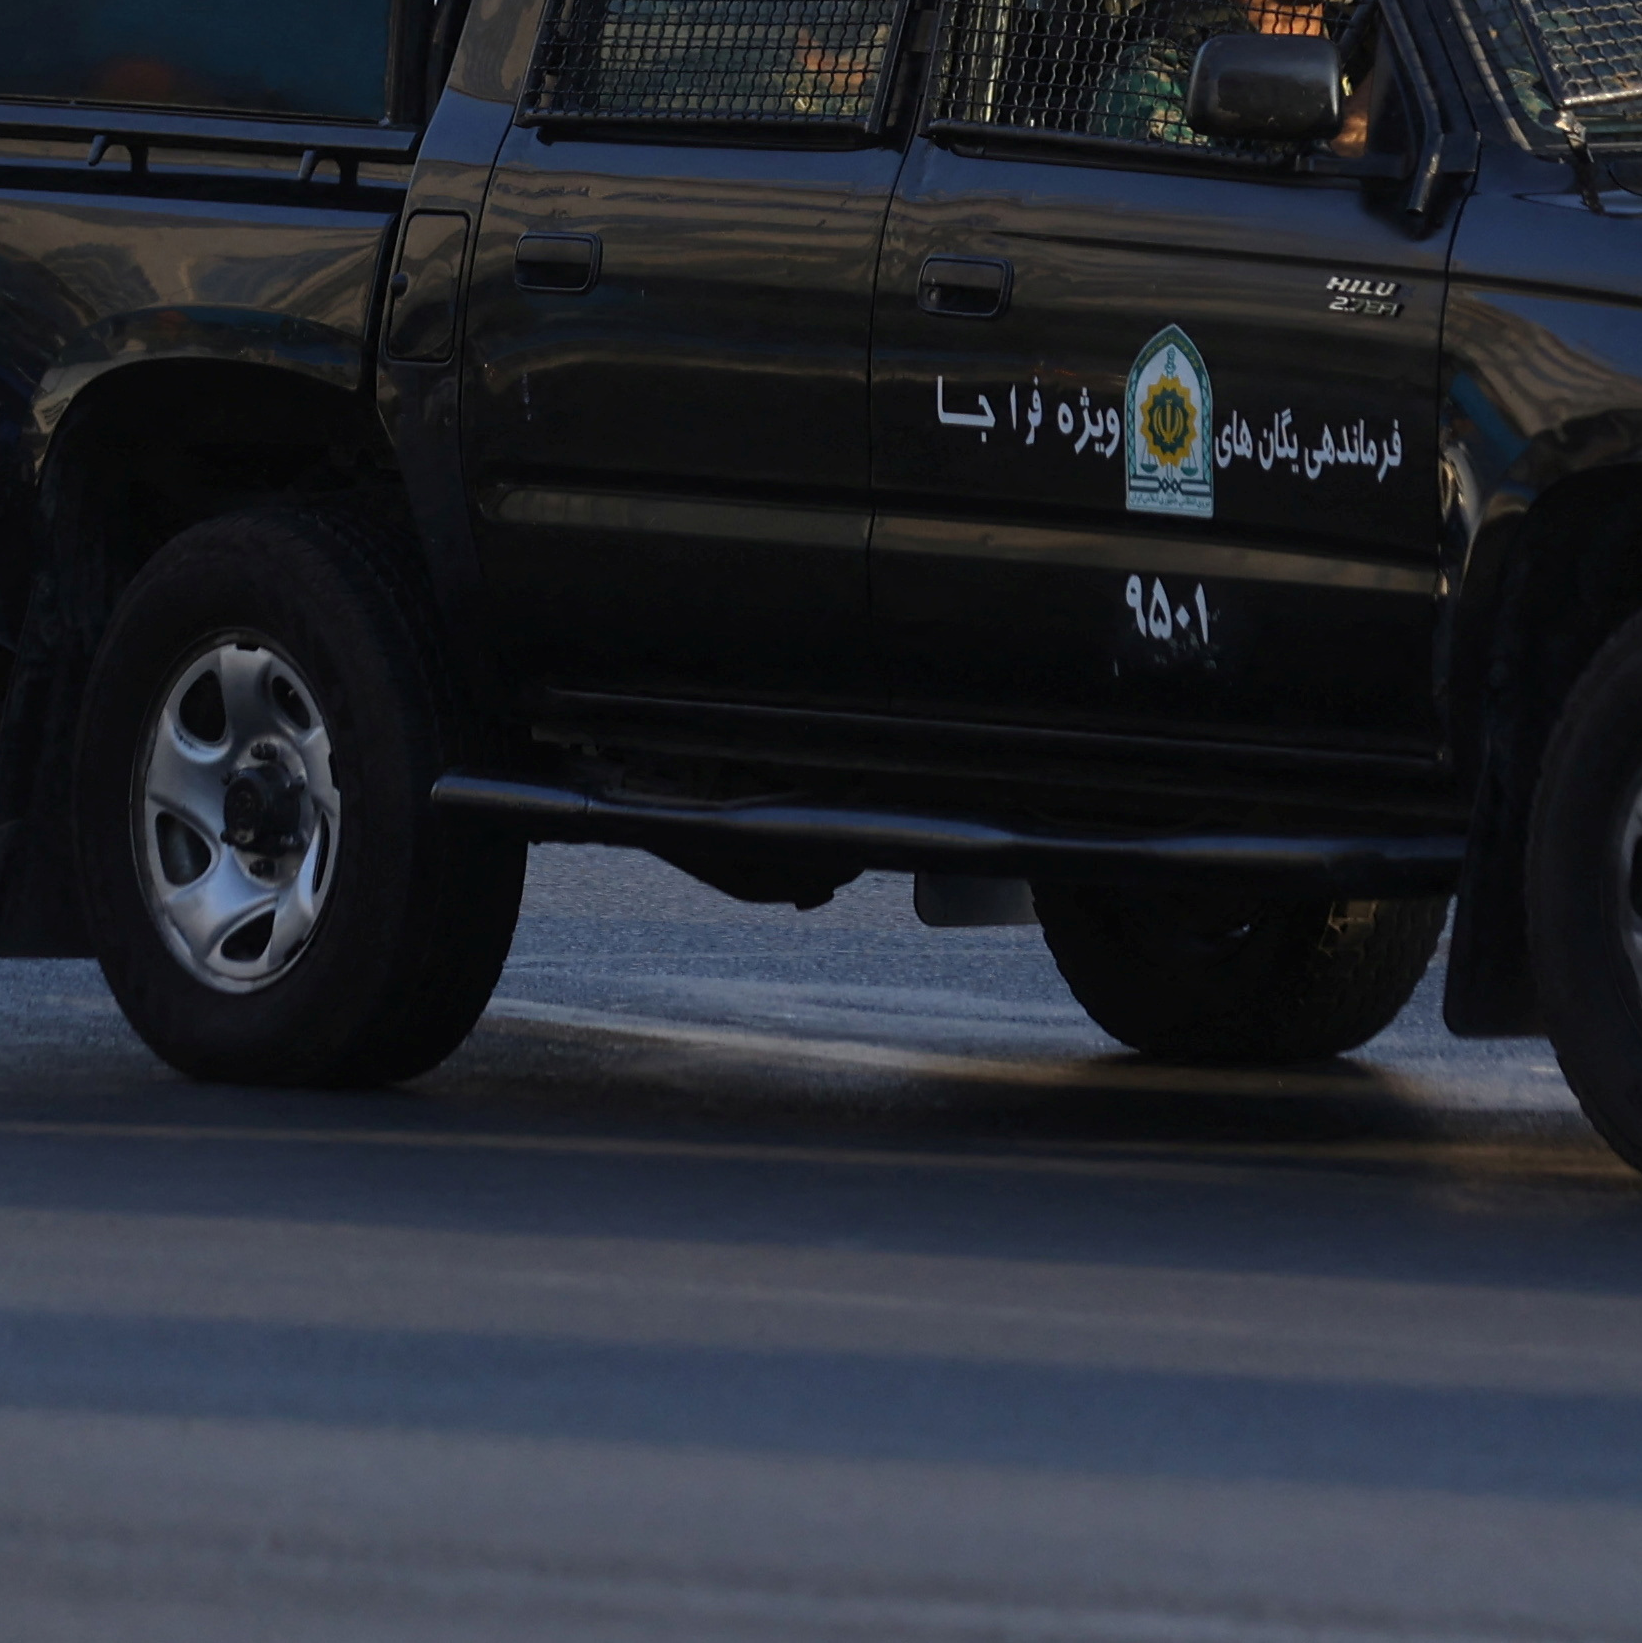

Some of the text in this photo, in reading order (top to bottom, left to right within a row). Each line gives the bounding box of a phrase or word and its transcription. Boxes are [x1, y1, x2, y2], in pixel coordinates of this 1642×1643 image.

[1058, 387, 1120, 458] ویژه
[1215, 410, 1253, 468] های
[1259, 408, 1299, 473] یگان
[1305, 419, 1402, 482] فرماندهی
[1125, 574, 1208, 645] ۹۵۰۱
